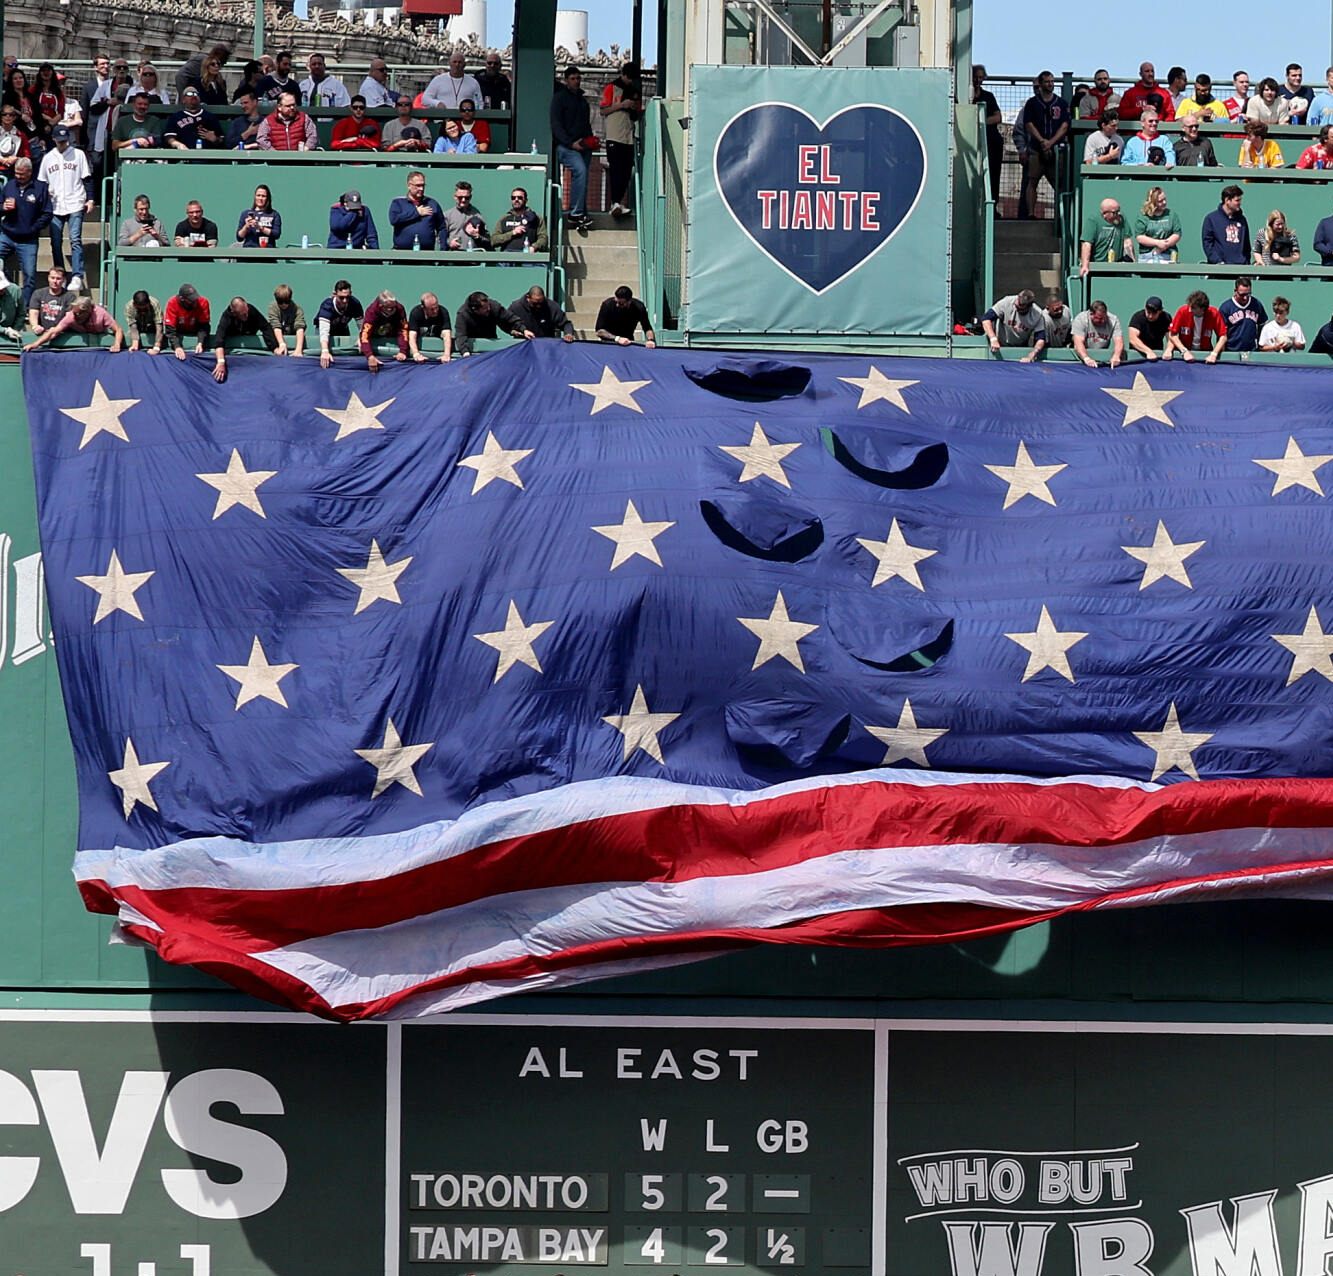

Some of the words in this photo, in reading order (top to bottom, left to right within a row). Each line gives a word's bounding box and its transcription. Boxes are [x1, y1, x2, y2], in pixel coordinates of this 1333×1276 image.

[798, 145, 840, 183] EL
[757, 190, 880, 231] TIANTE
[519, 1047, 584, 1078] AL
[618, 1049, 758, 1080] EAST
[0, 1069, 288, 1220] VS
[641, 1119, 667, 1151] W
[707, 1120, 729, 1152] L
[757, 1120, 808, 1153] GB
[411, 1174, 587, 1208] TORONTO
[642, 1175, 664, 1210] 5
[706, 1176, 727, 1210] 2
[906, 1158, 1026, 1206] WHO
[1038, 1157, 1133, 1205] BUT
[410, 1227, 524, 1260] TAMPA
[539, 1229, 604, 1262] BAY
[641, 1229, 664, 1263] 4
[705, 1229, 727, 1263] 2
